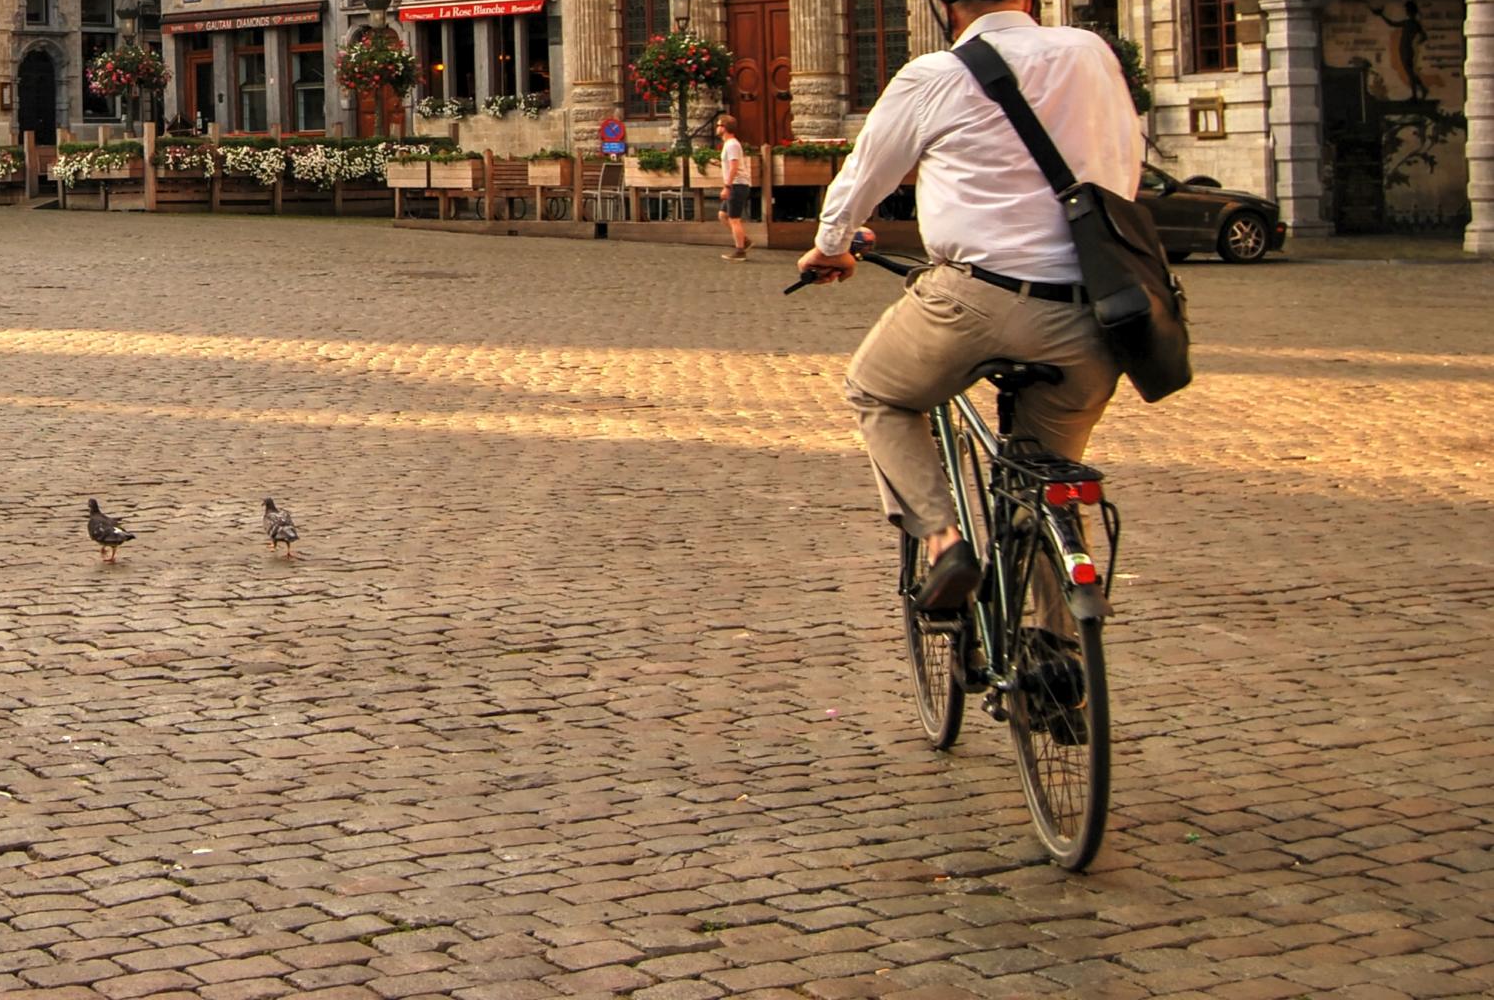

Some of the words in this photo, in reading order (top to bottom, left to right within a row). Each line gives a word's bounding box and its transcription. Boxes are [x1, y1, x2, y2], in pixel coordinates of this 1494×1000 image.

[439, 8, 451, 18] La
[452, 6, 472, 17] Rose
[473, 4, 506, 15] Blanche
[205, 19, 233, 31] GAUTAM
[236, 16, 270, 29] DIAMONDS
